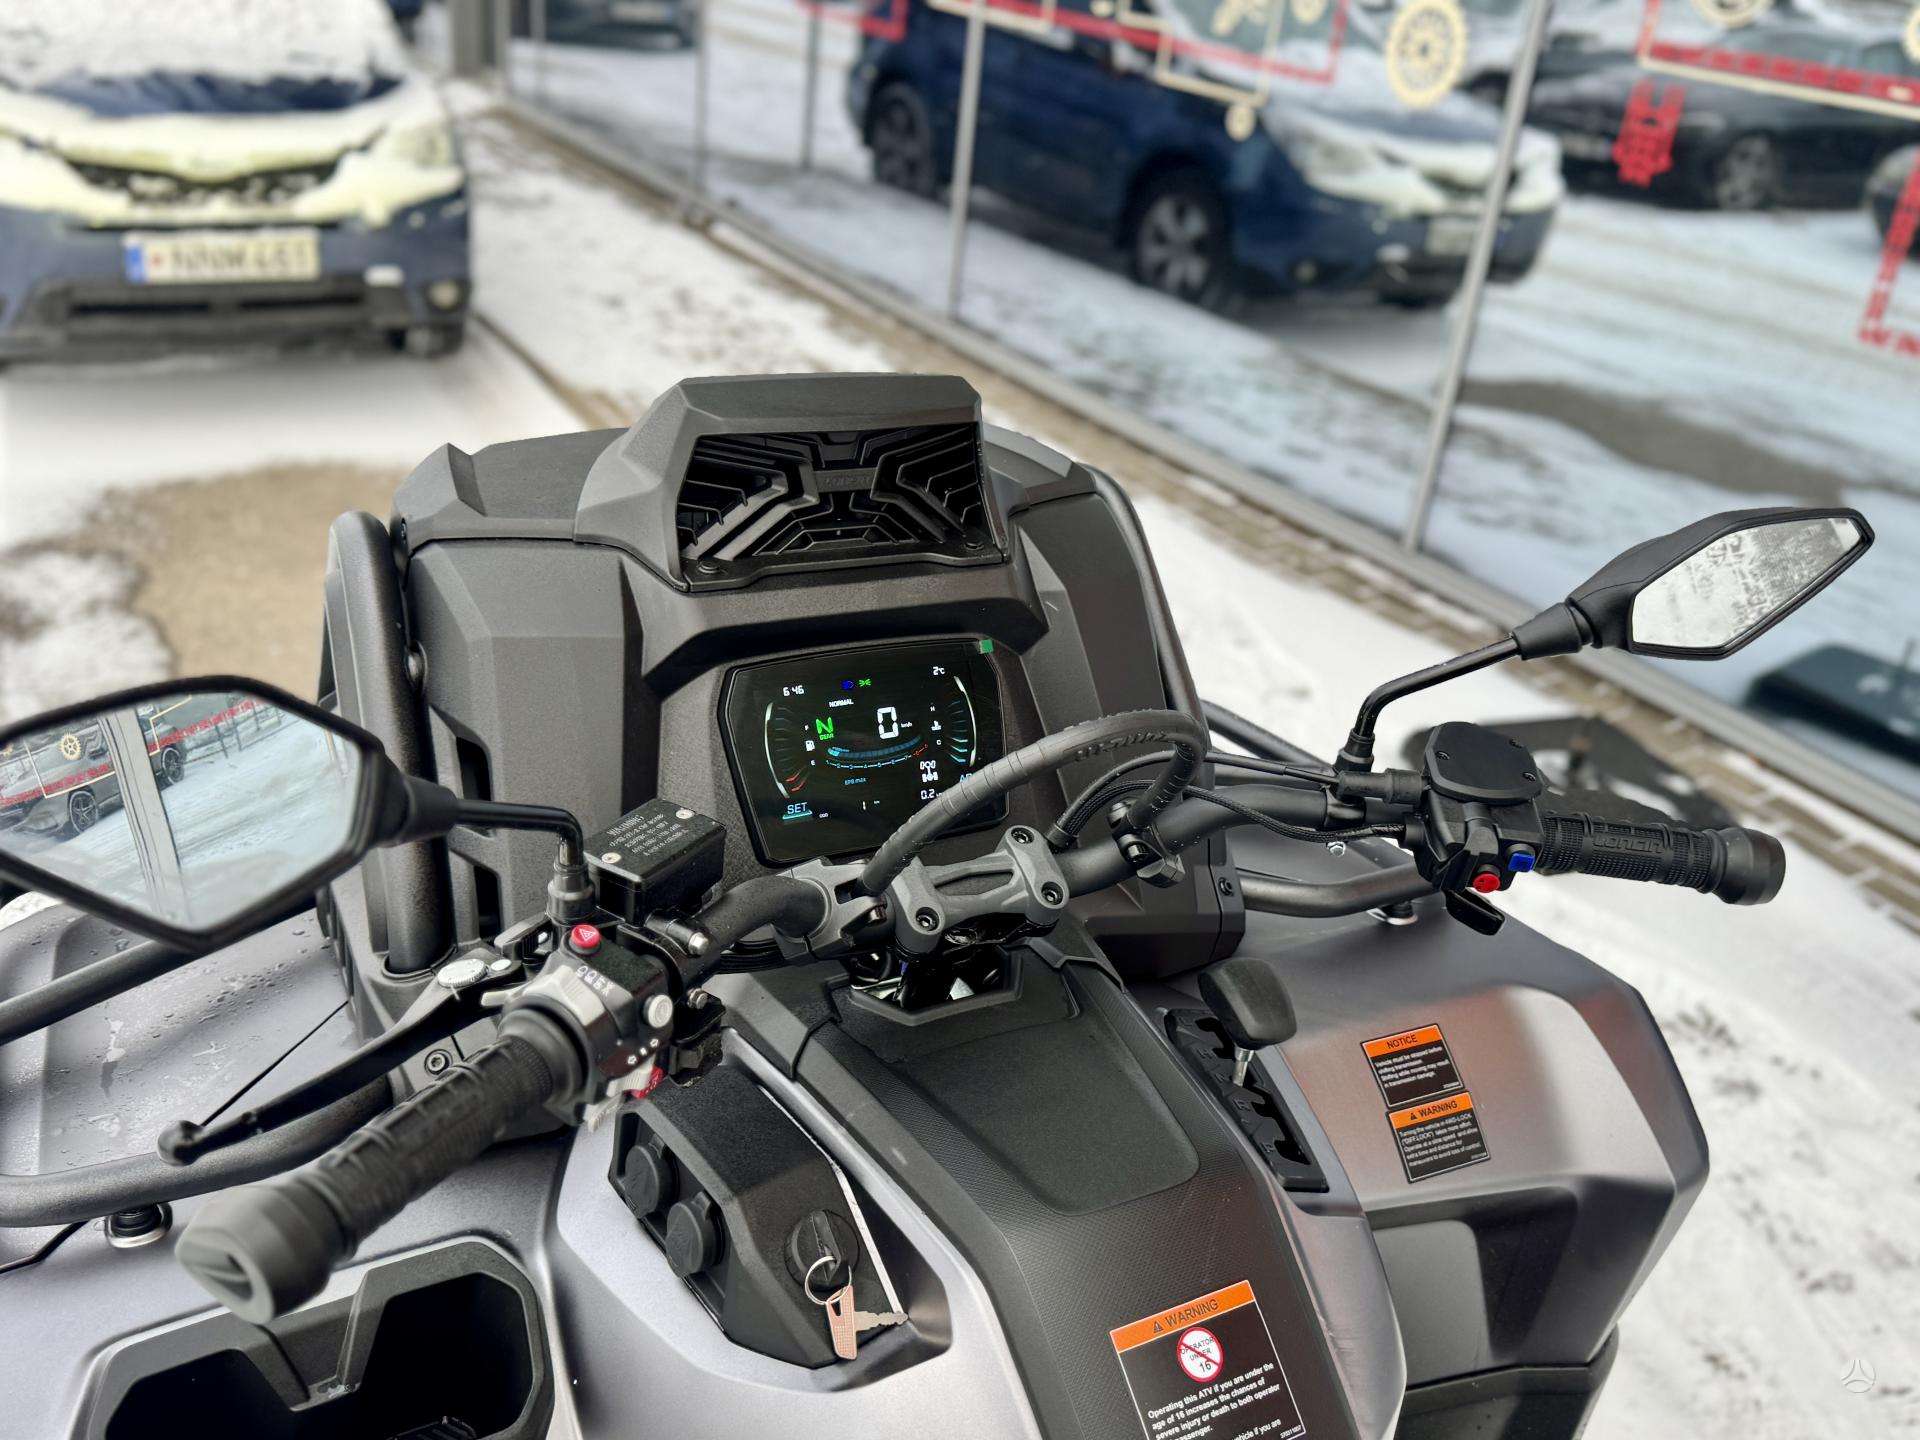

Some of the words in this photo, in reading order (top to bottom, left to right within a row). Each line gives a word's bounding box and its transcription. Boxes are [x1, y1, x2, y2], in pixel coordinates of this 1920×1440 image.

[829, 699, 854, 708] NORMAL
[815, 716, 834, 734] N
[877, 706, 899, 739] 0
[787, 801, 808, 814] SET
[1386, 1034, 1418, 1049] NOTICE
[1418, 1100, 1458, 1117] WARNING
[1165, 1299, 1218, 1327] WARNING
[1200, 1360, 1211, 1372] 16
[1147, 1400, 1184, 1419] Operating
[1183, 1394, 1198, 1404] this
[1198, 1386, 1213, 1399] ATV
[1213, 1383, 1219, 1392] if
[1220, 1380, 1233, 1392] you
[1233, 1375, 1244, 1384] are
[1244, 1366, 1263, 1379] under
[1263, 1362, 1274, 1372] the
[1152, 1420, 1166, 1430] age
[1167, 1414, 1175, 1424] of
[1175, 1410, 1185, 1420] 16
[1185, 1398, 1218, 1416] increases
[1218, 1393, 1231, 1403] the
[1231, 1381, 1257, 1398] chances
[1257, 1376, 1265, 1386] of
[1155, 1426, 1180, 1440] severe
[1180, 1417, 1201, 1431] injury
[1201, 1413, 1210, 1422] or
[1210, 1404, 1230, 1418] death
[1230, 1402, 1238, 1410] to
[1237, 1394, 1254, 1407] both
[1254, 1383, 1280, 1400] operator
[1258, 1423, 1271, 1435] you
[1271, 1418, 1281, 1428] are
